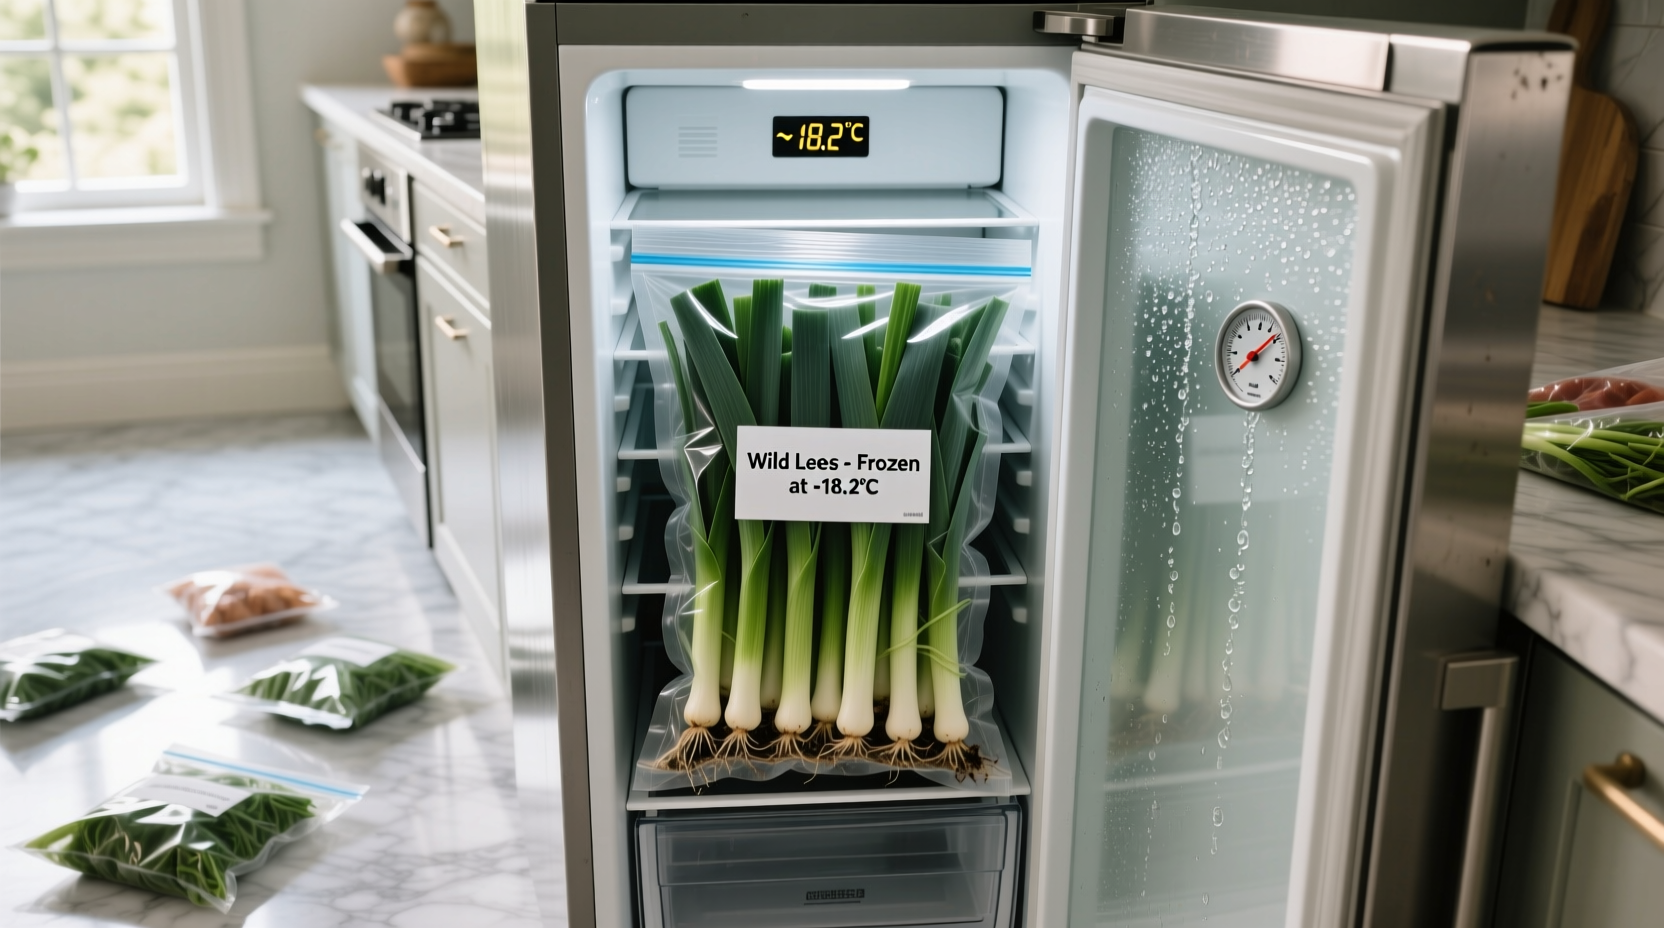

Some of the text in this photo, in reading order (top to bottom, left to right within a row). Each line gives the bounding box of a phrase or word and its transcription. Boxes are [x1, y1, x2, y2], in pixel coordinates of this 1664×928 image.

[747, 451, 790, 470] Wild
[795, 452, 839, 471] Lees
[857, 453, 921, 472] Frozen
[788, 478, 808, 495] at
